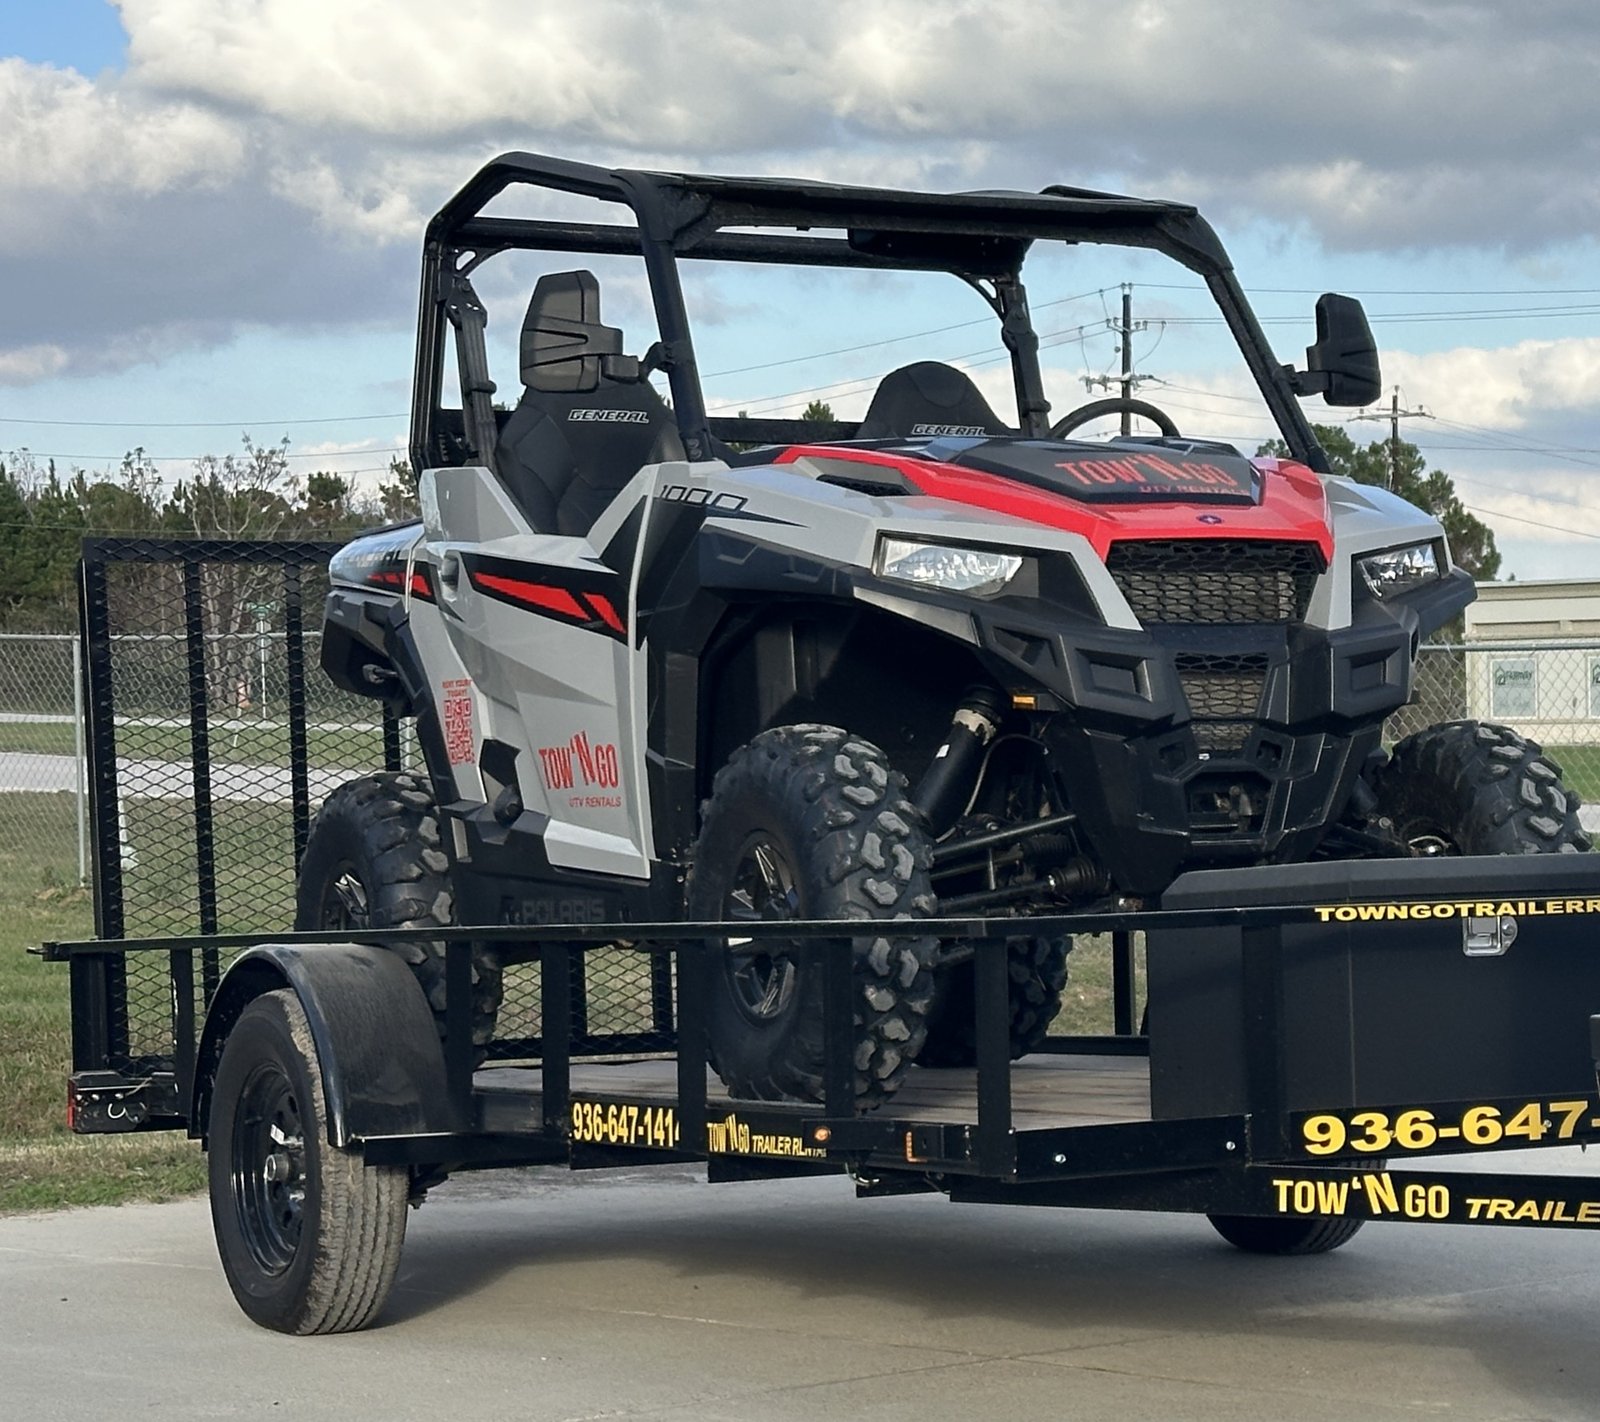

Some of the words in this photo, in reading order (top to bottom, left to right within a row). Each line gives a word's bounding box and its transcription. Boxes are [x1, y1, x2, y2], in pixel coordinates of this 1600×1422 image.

[568, 409, 649, 424] GENERAL
[911, 423, 987, 436] GENERAL
[660, 484, 749, 513] 1000
[568, 796, 583, 808] UTV
[585, 796, 622, 808] RENTALS
[522, 900, 605, 921] POLARIS
[1314, 899, 1600, 922] TOWNGOTRAILERR
[752, 1134, 791, 1155] TRAILER
[1465, 1198, 1600, 1222] TRAILE
